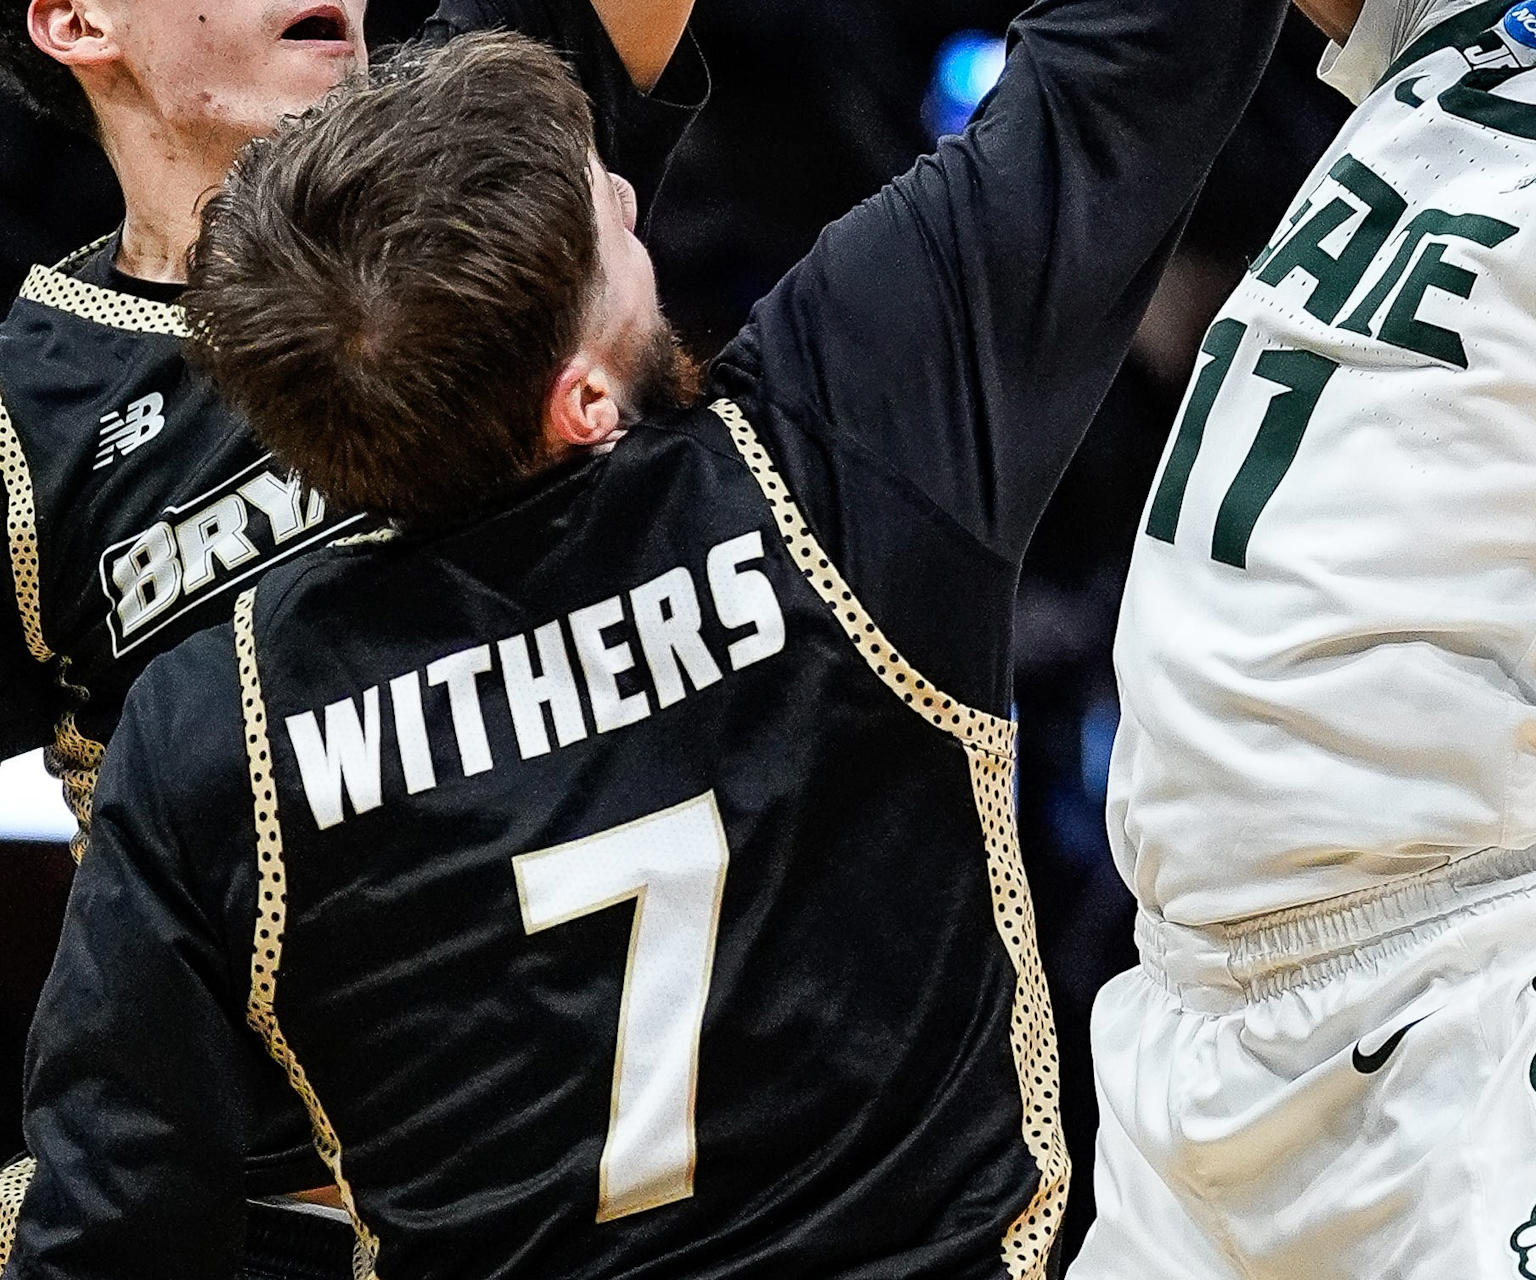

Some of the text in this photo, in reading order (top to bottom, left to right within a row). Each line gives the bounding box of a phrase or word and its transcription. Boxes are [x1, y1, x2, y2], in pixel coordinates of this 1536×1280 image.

[1145, 317, 1341, 569] 11
[284, 530, 787, 830] WITHERS
[511, 788, 729, 1223] 7
